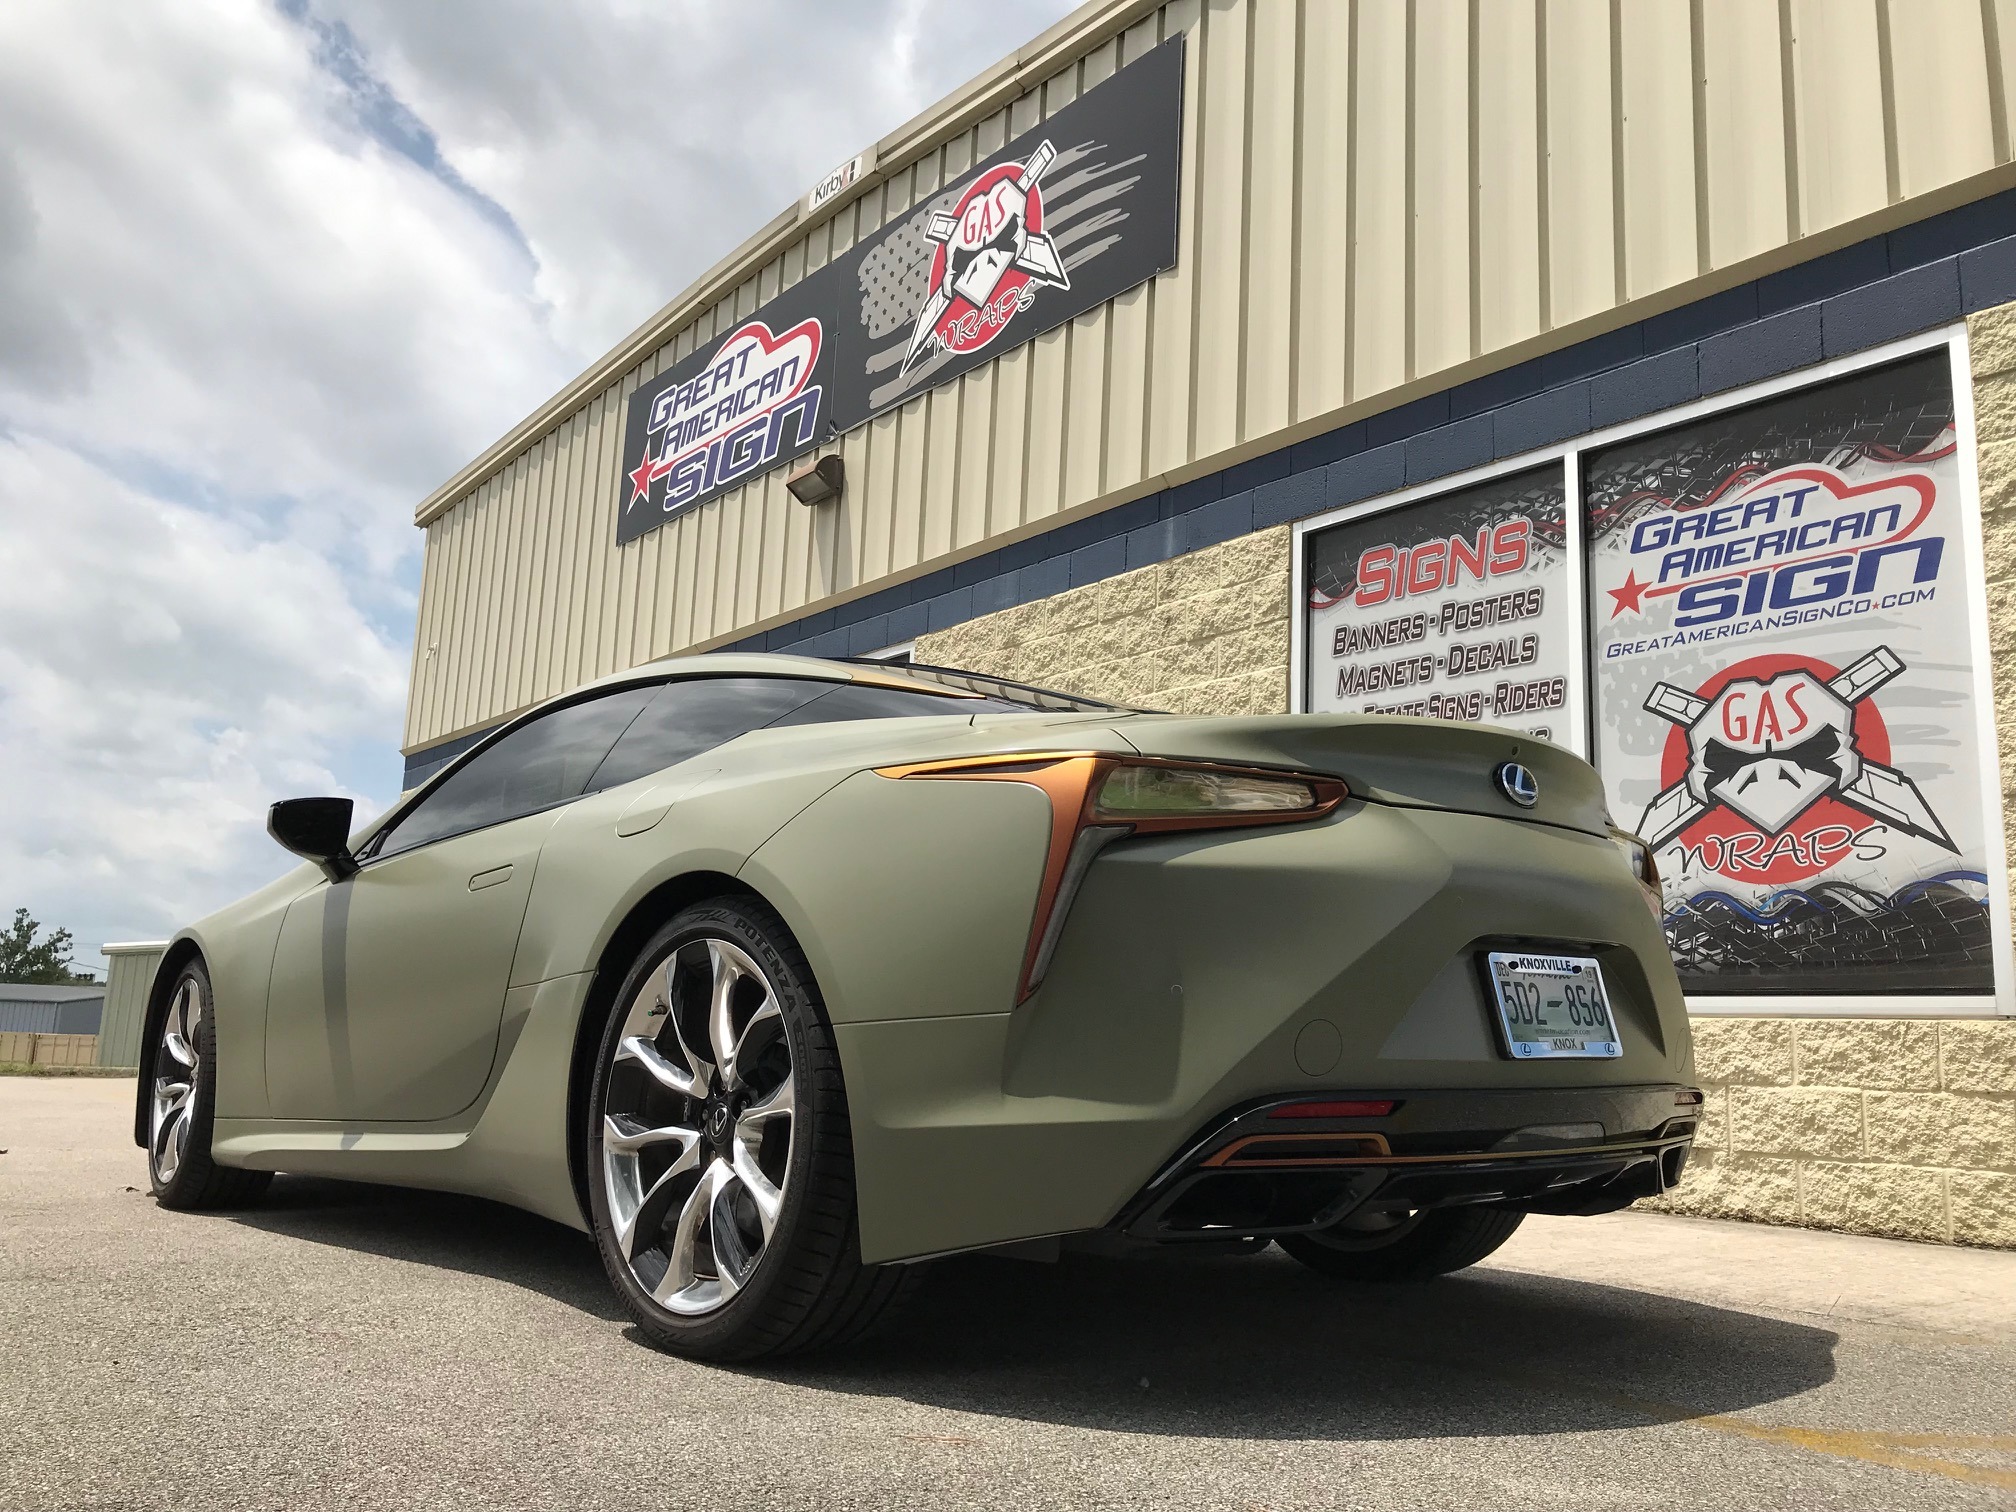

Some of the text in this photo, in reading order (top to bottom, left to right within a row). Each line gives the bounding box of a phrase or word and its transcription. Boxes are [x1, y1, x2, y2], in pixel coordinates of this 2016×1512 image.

[814, 174, 843, 204] Kirby
[963, 185, 1007, 245] GAS
[926, 279, 1036, 359] WRAPS
[650, 342, 757, 429] GREAT
[660, 355, 799, 461] AMERICAN
[664, 388, 821, 510] SIGN
[1630, 486, 1819, 554] GREAT
[1658, 503, 1902, 583] AMERICAN
[1354, 519, 1534, 608] SIGNS
[1674, 536, 1946, 628] SIGN
[1333, 587, 1543, 656] BANNERS POSTERS
[1336, 634, 1537, 697] MAGNETS DECALS
[1428, 693, 1481, 721] SIGNS
[1493, 677, 1565, 716] RIDERS
[1721, 682, 1808, 745] GAS
[1667, 823, 1888, 874] WRAPS
[733, 917, 796, 1014] POTENZA
[1518, 957, 1573, 972] KNOXVILLE
[1552, 1037, 1578, 1050] KNOX
